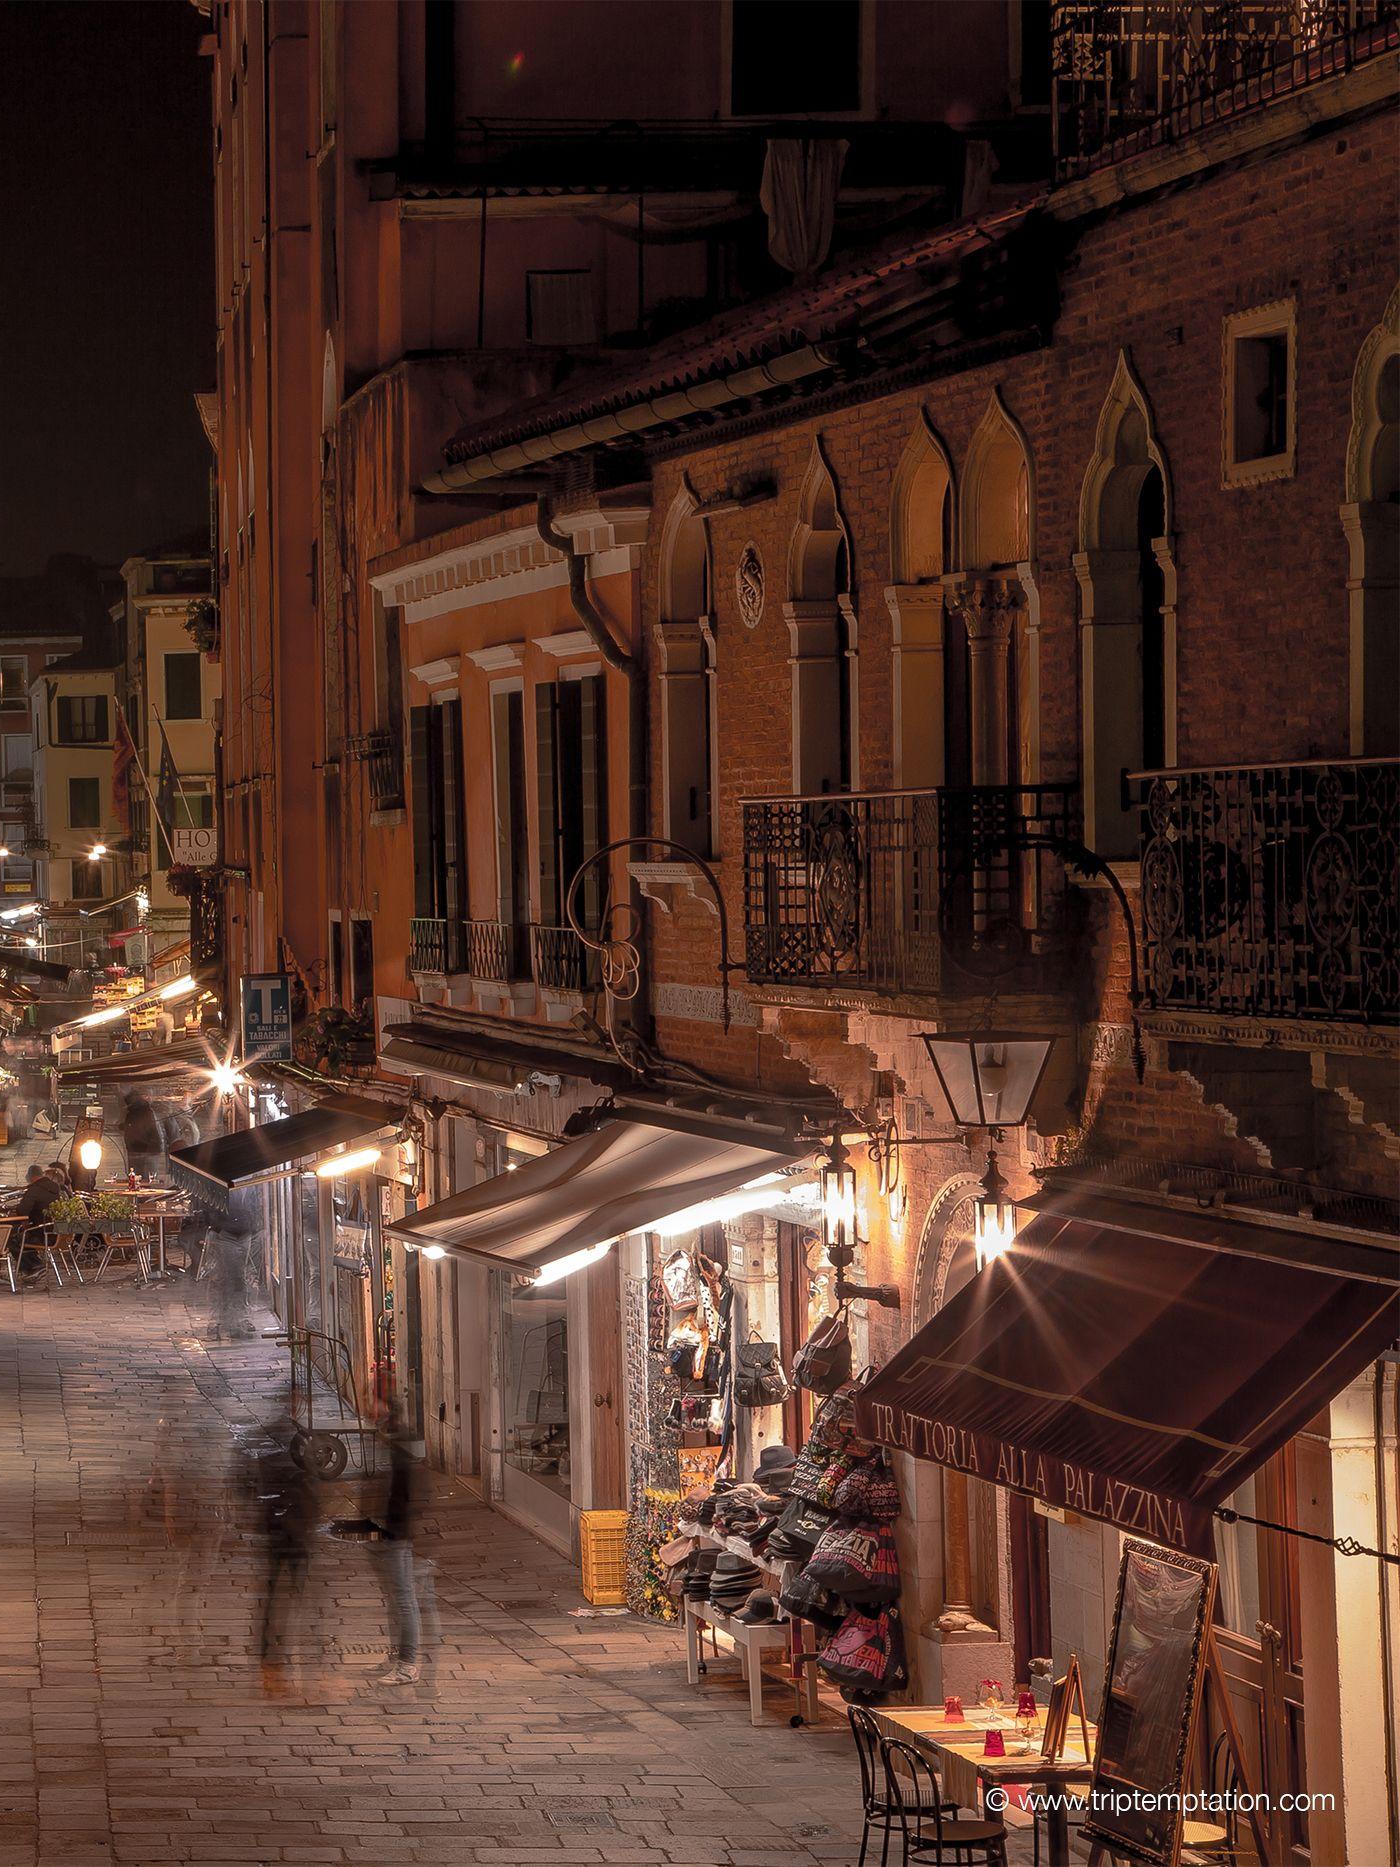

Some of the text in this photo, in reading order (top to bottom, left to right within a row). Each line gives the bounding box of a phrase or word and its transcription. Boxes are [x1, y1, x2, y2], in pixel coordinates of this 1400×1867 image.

[251, 980, 281, 1025] T
[248, 1031, 287, 1041] TABACCHI
[871, 1401, 981, 1472] TRATTORIA
[995, 1441, 1048, 1497] ALLA
[1062, 1462, 1188, 1548] PALAZZINA
